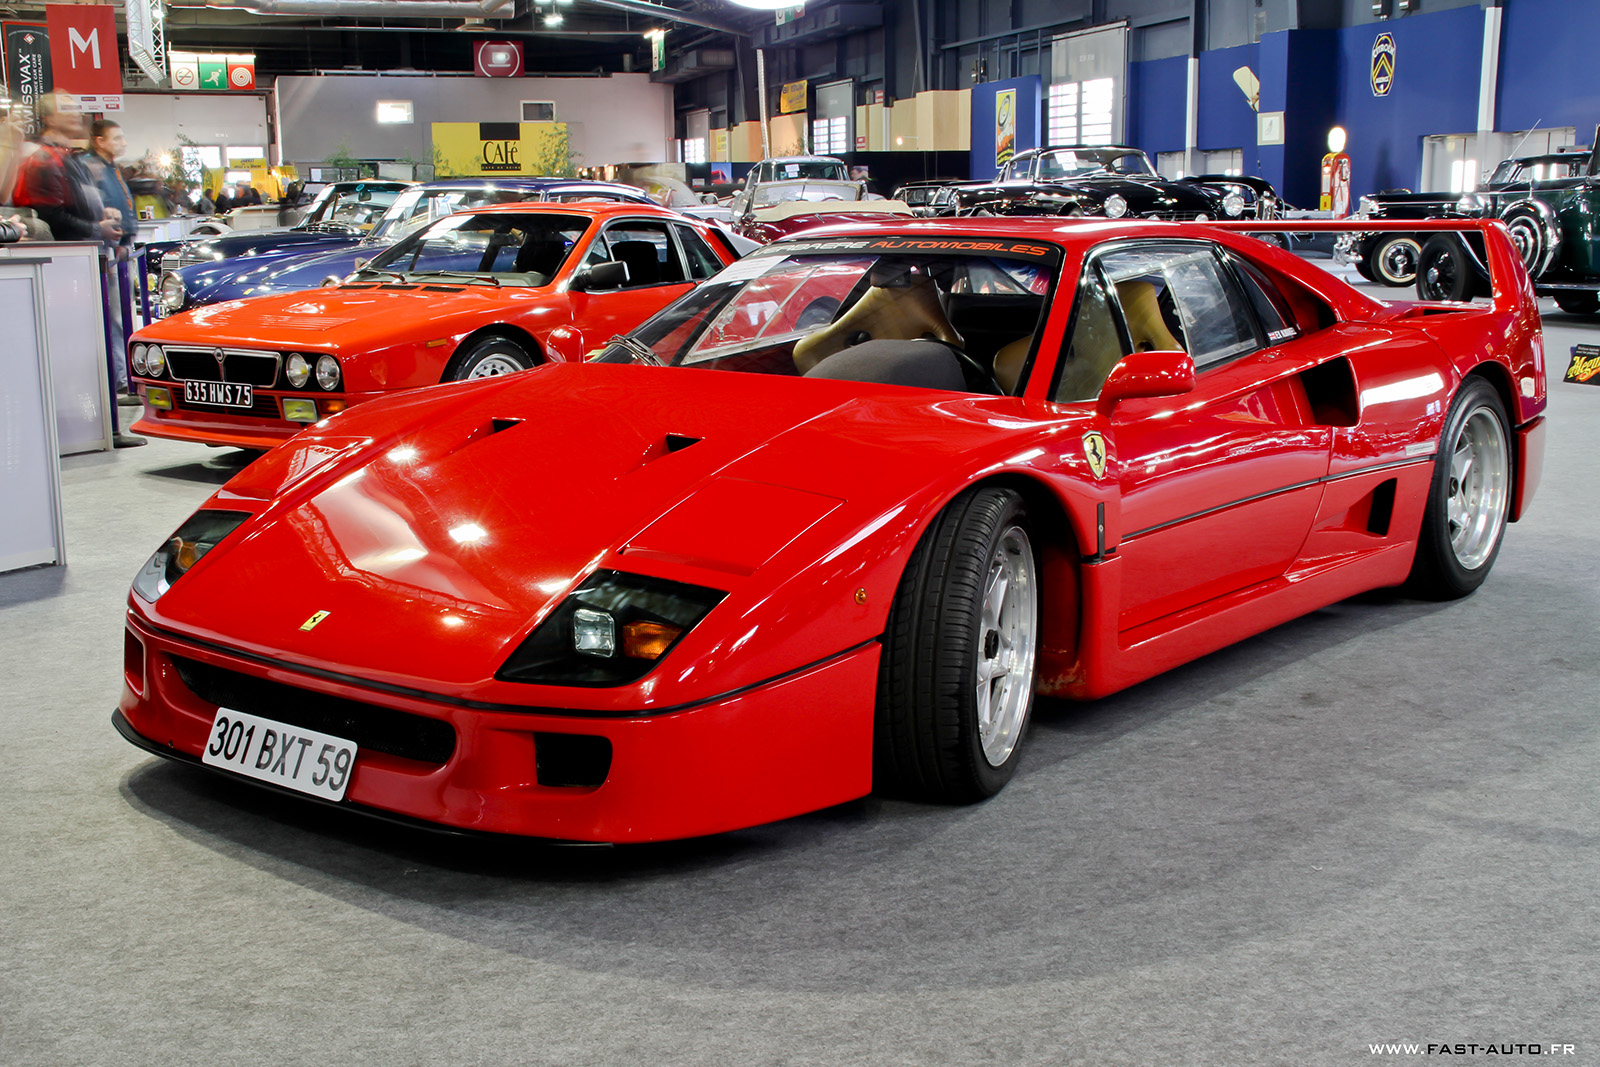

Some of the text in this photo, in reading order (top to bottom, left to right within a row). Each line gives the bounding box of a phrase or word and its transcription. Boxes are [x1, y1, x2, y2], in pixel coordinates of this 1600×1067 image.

[68, 27, 101, 69] M
[869, 241, 1050, 256] AUTOMOBILES
[186, 381, 251, 405] 635 HWS 75
[209, 716, 351, 791] 301 BXT 59
